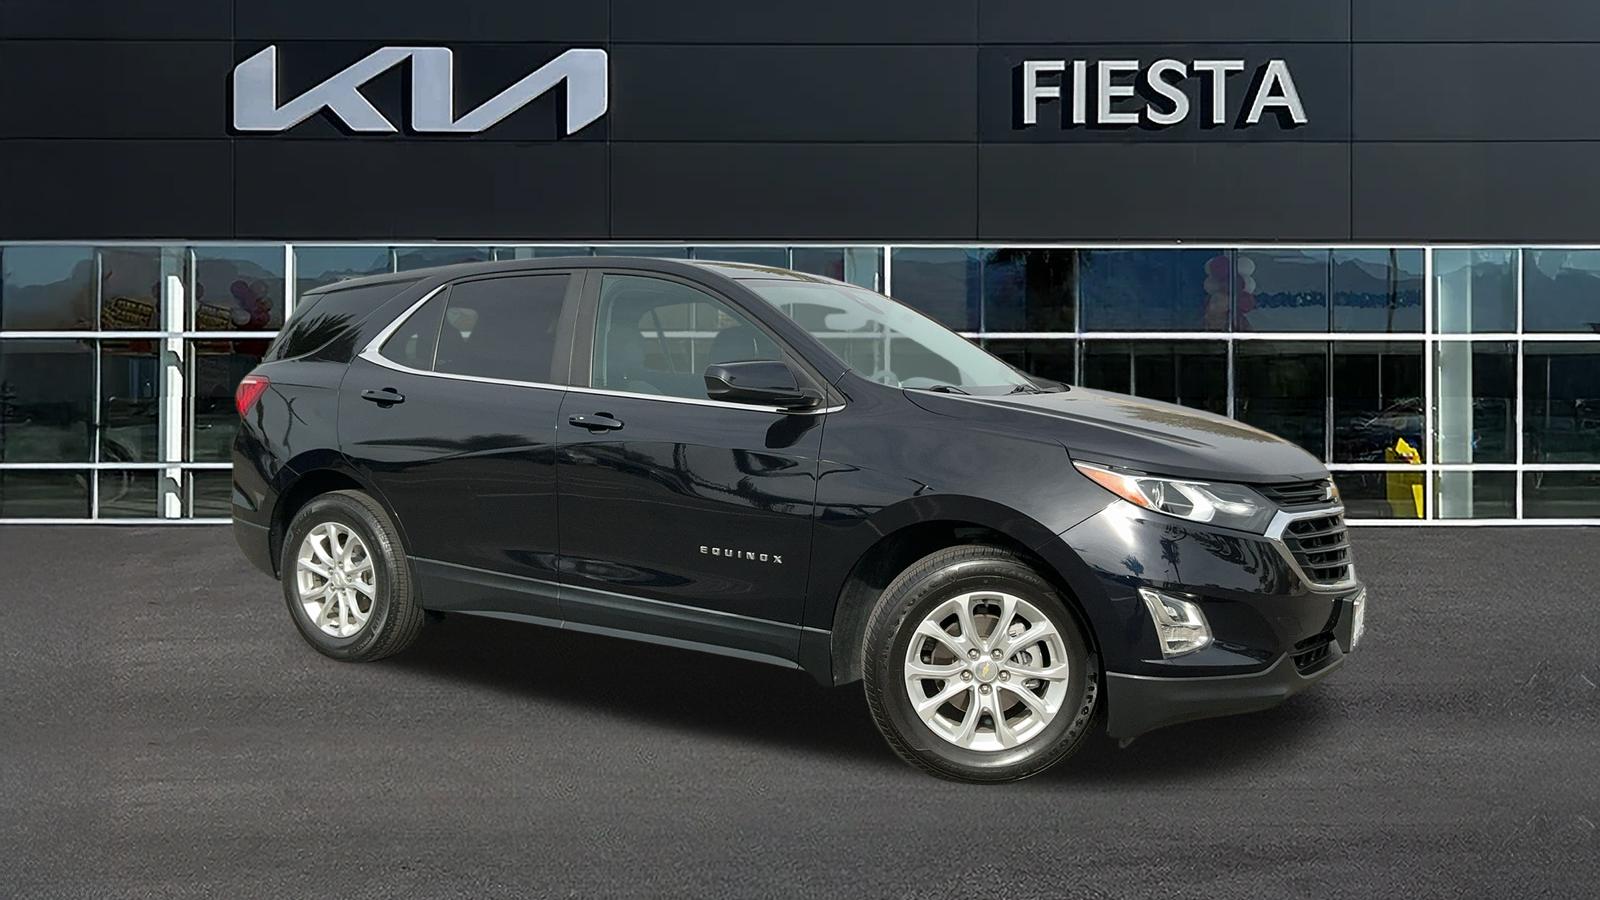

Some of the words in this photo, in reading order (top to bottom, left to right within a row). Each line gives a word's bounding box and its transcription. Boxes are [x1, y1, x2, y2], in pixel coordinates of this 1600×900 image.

[233, 45, 608, 135] KIA
[1023, 59, 1308, 125] FIESTA
[699, 545, 783, 564] EQUINOX
